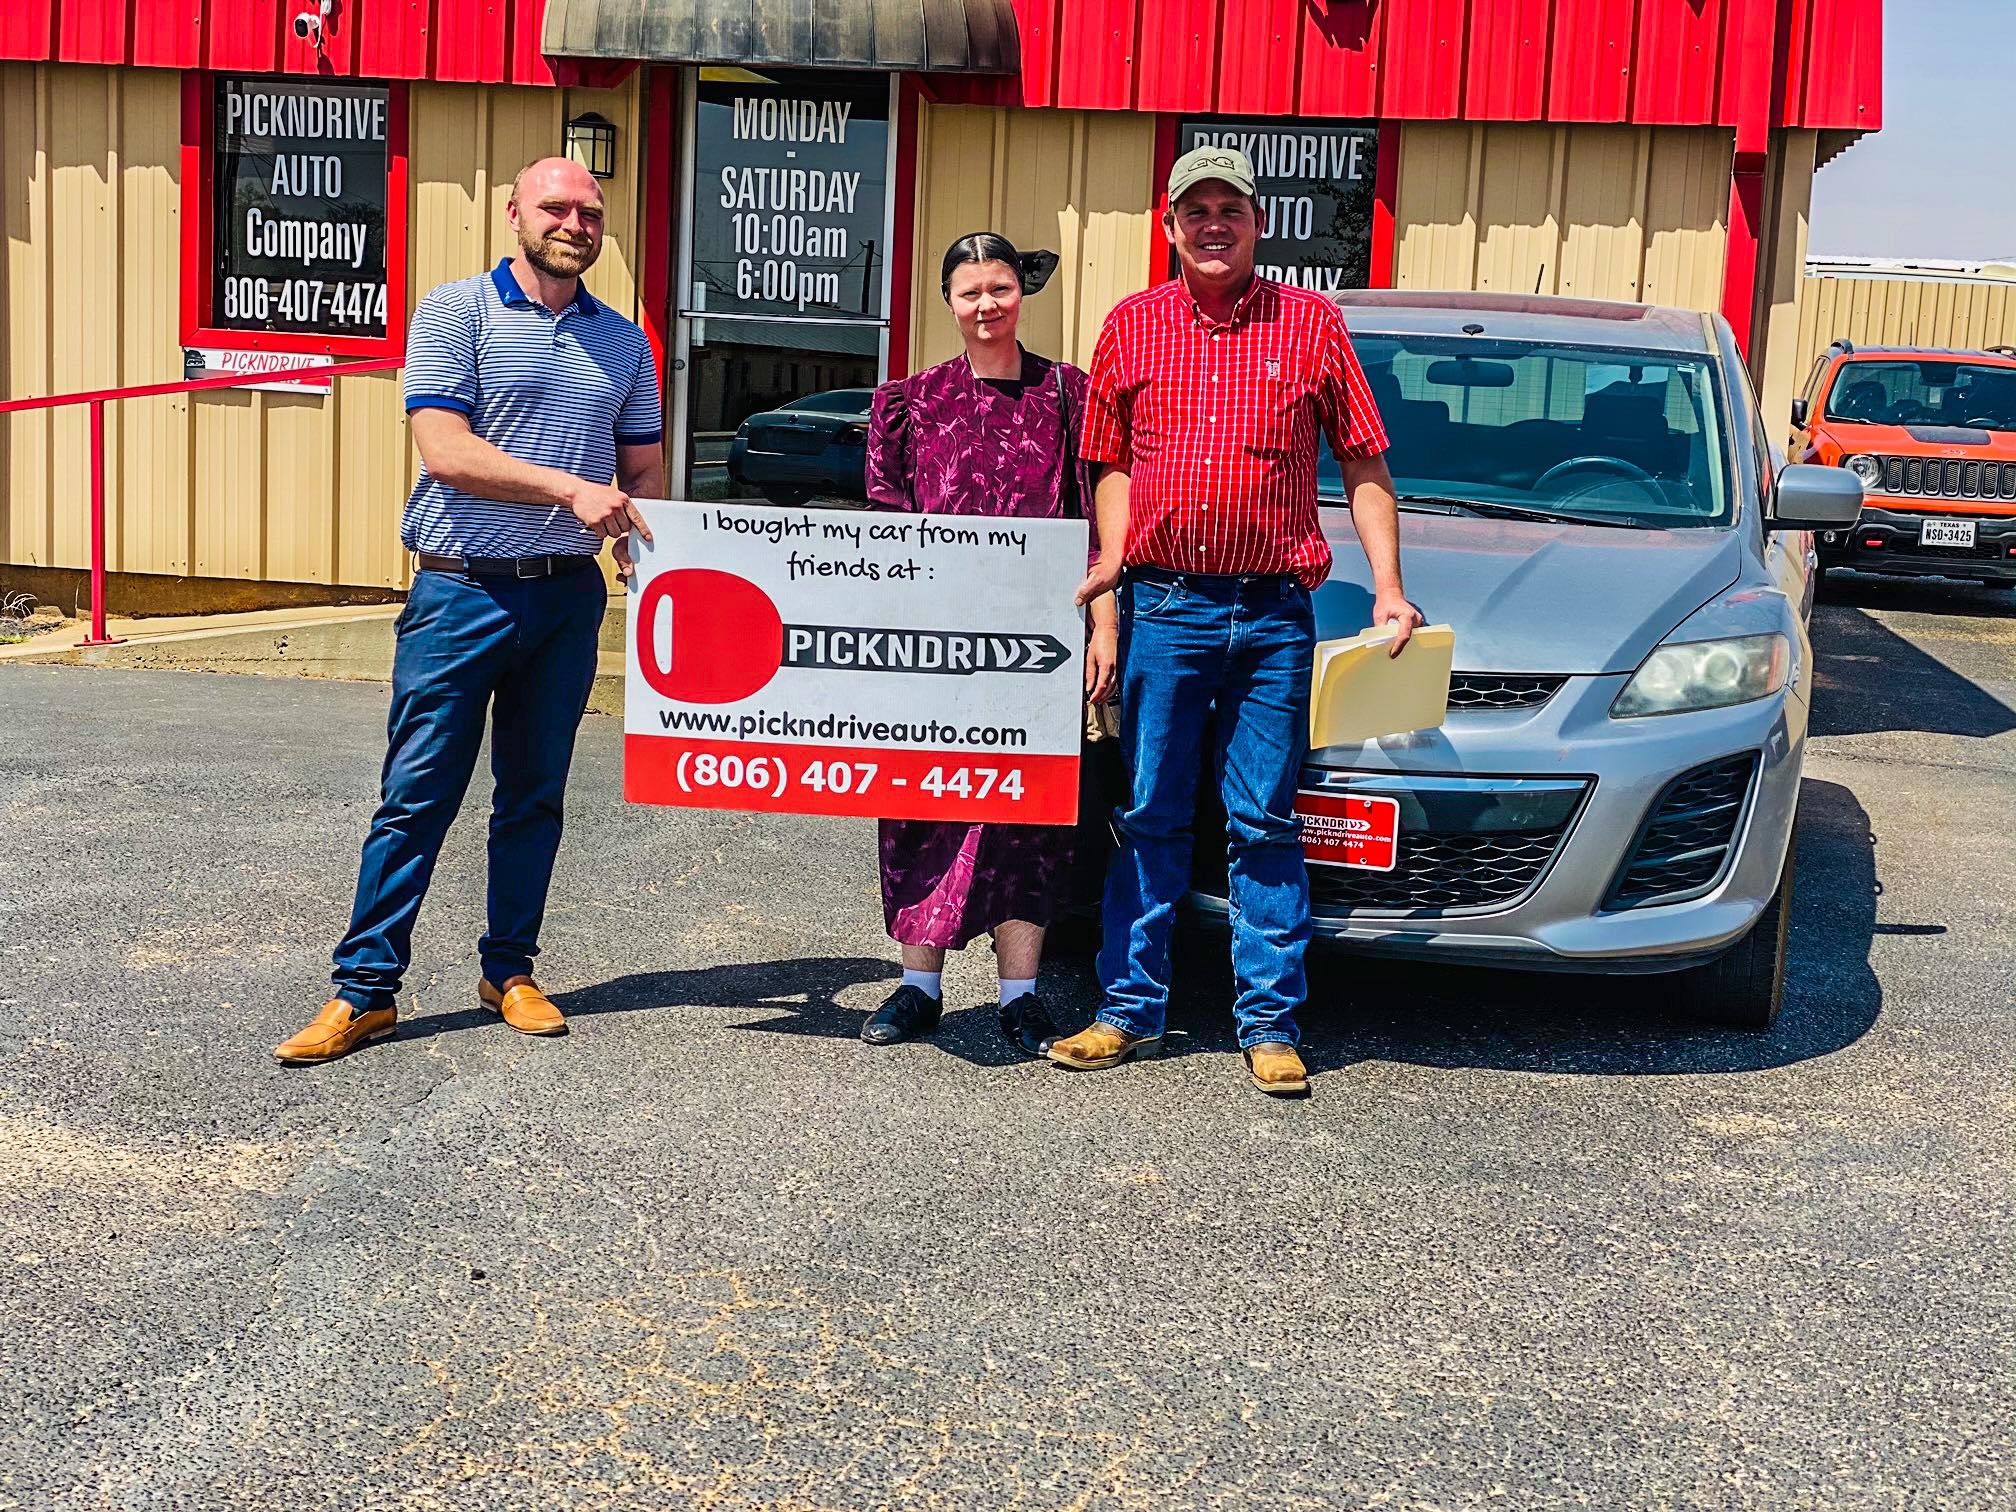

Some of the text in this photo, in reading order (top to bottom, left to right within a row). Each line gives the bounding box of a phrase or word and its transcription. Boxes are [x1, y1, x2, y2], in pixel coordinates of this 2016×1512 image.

[227, 93, 385, 141] PICKNDRIVE
[733, 97, 852, 144] MONDAY
[270, 154, 341, 198] AUTO
[720, 166, 861, 214] SATURDAY
[246, 207, 367, 268] Company
[731, 213, 847, 258] 10:00am
[1260, 196, 1313, 240] UTO
[224, 276, 388, 326] 806-407-4474
[737, 258, 839, 312] 6:00pm
[702, 509, 1027, 556] I bought my car from my
[787, 551, 880, 581] friends
[788, 629, 1057, 669] PICKNDRIVE
[659, 709, 1027, 747] www.pickndriveauto.com
[676, 751, 788, 798] (806)
[800, 759, 878, 795] 407
[920, 766, 1025, 800] 4474
[1302, 828, 1391, 842] ww.pickndriveauto.com
[1324, 838, 1340, 847] 407
[1343, 840, 1364, 849] 4474
